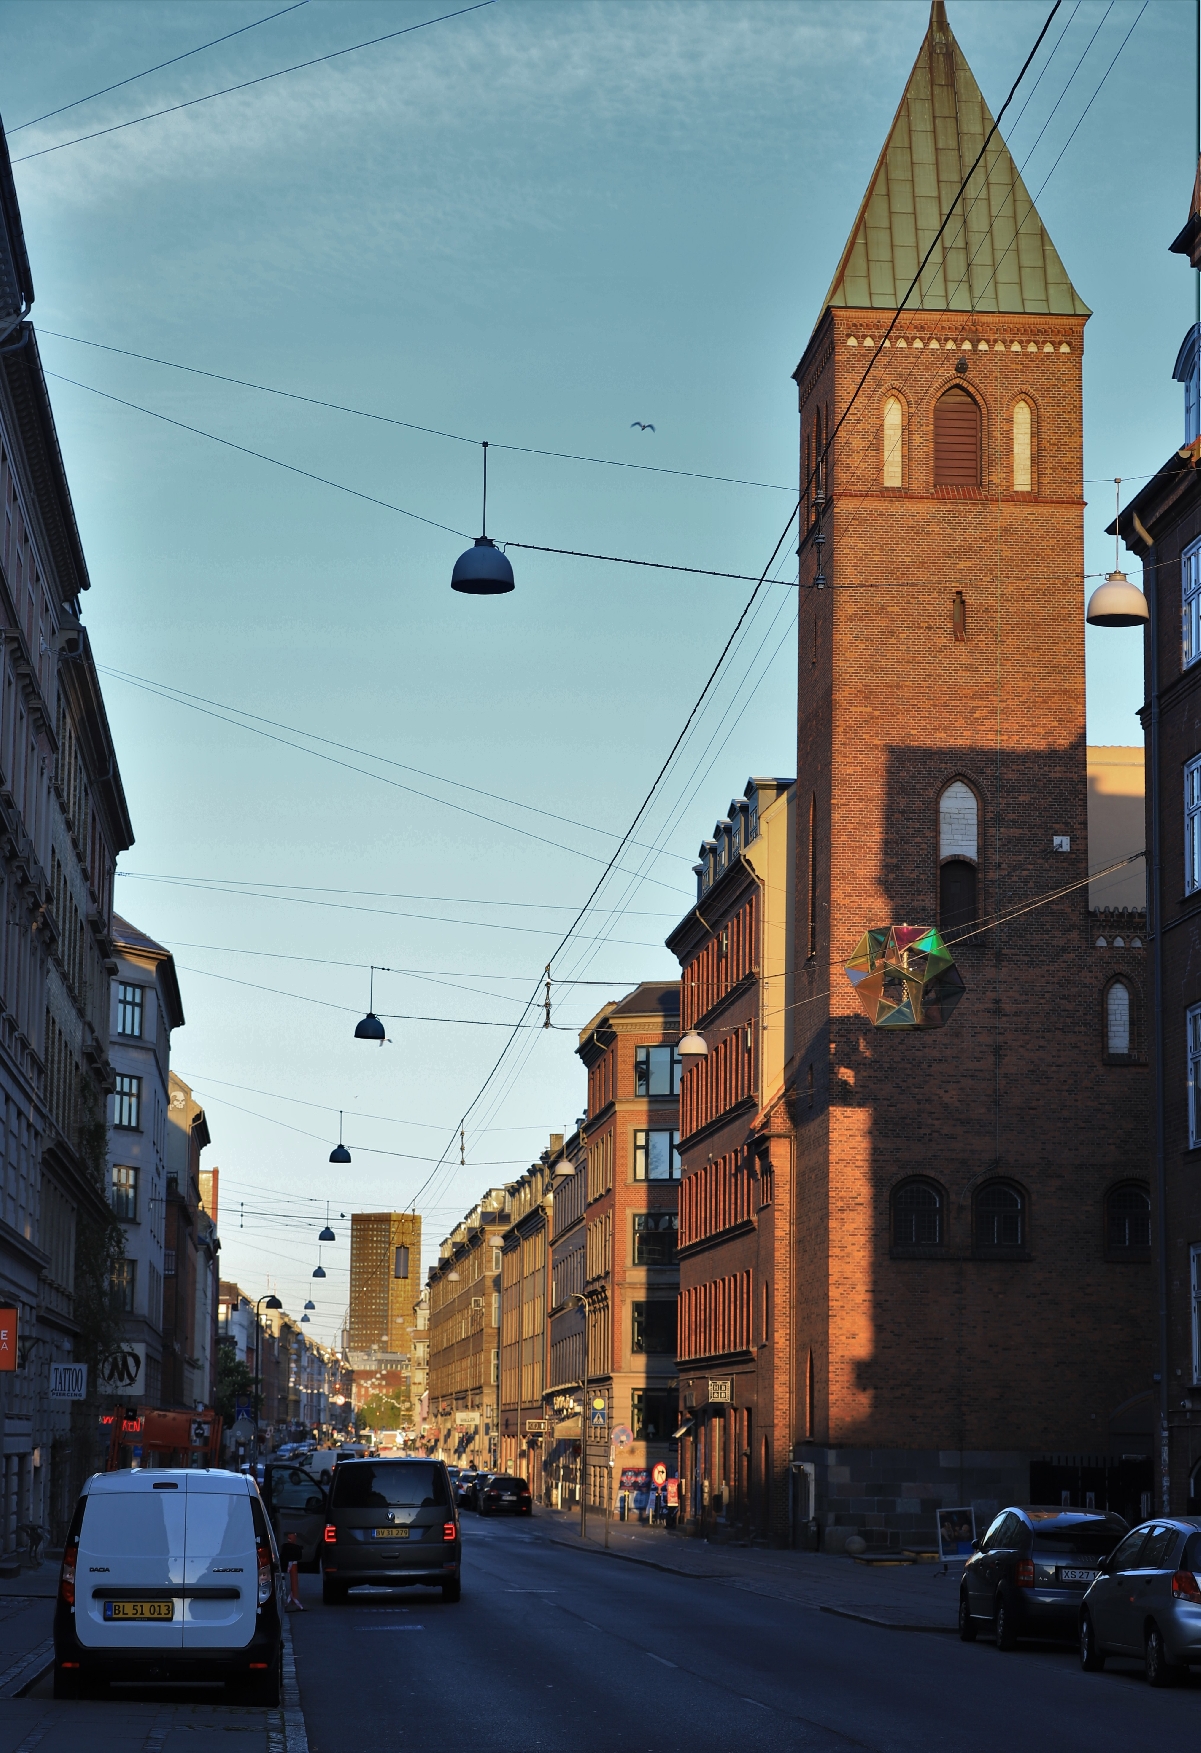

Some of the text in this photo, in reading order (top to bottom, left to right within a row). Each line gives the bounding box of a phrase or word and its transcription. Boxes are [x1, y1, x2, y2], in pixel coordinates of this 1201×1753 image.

[53, 1367, 83, 1392] TATTOO
[1063, 1571, 1077, 1579] XS
[113, 1604, 171, 1616] BL 51 013
